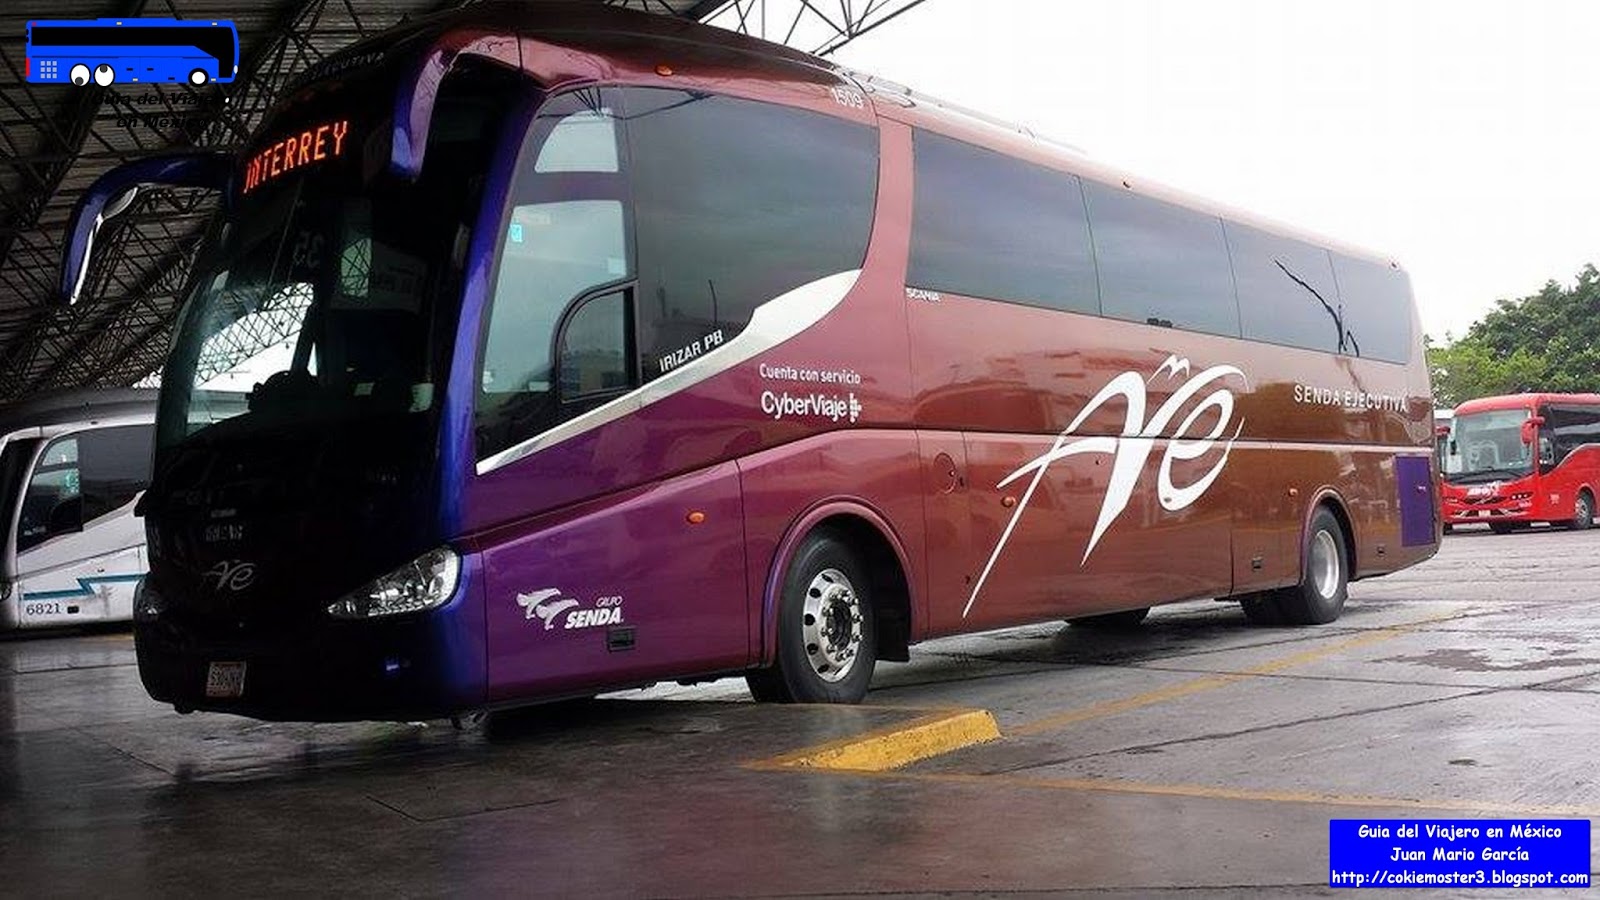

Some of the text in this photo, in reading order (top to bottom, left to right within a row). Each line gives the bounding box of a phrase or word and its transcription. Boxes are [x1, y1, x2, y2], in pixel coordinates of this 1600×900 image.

[831, 87, 864, 109] 1509
[659, 329, 724, 372] IRIZAR PB
[759, 363, 861, 384] Cuenta con servicio
[761, 391, 848, 422] CyberViaje
[1294, 384, 1409, 413] SENDA EJECUTIVA
[26, 603, 61, 615] 6821
